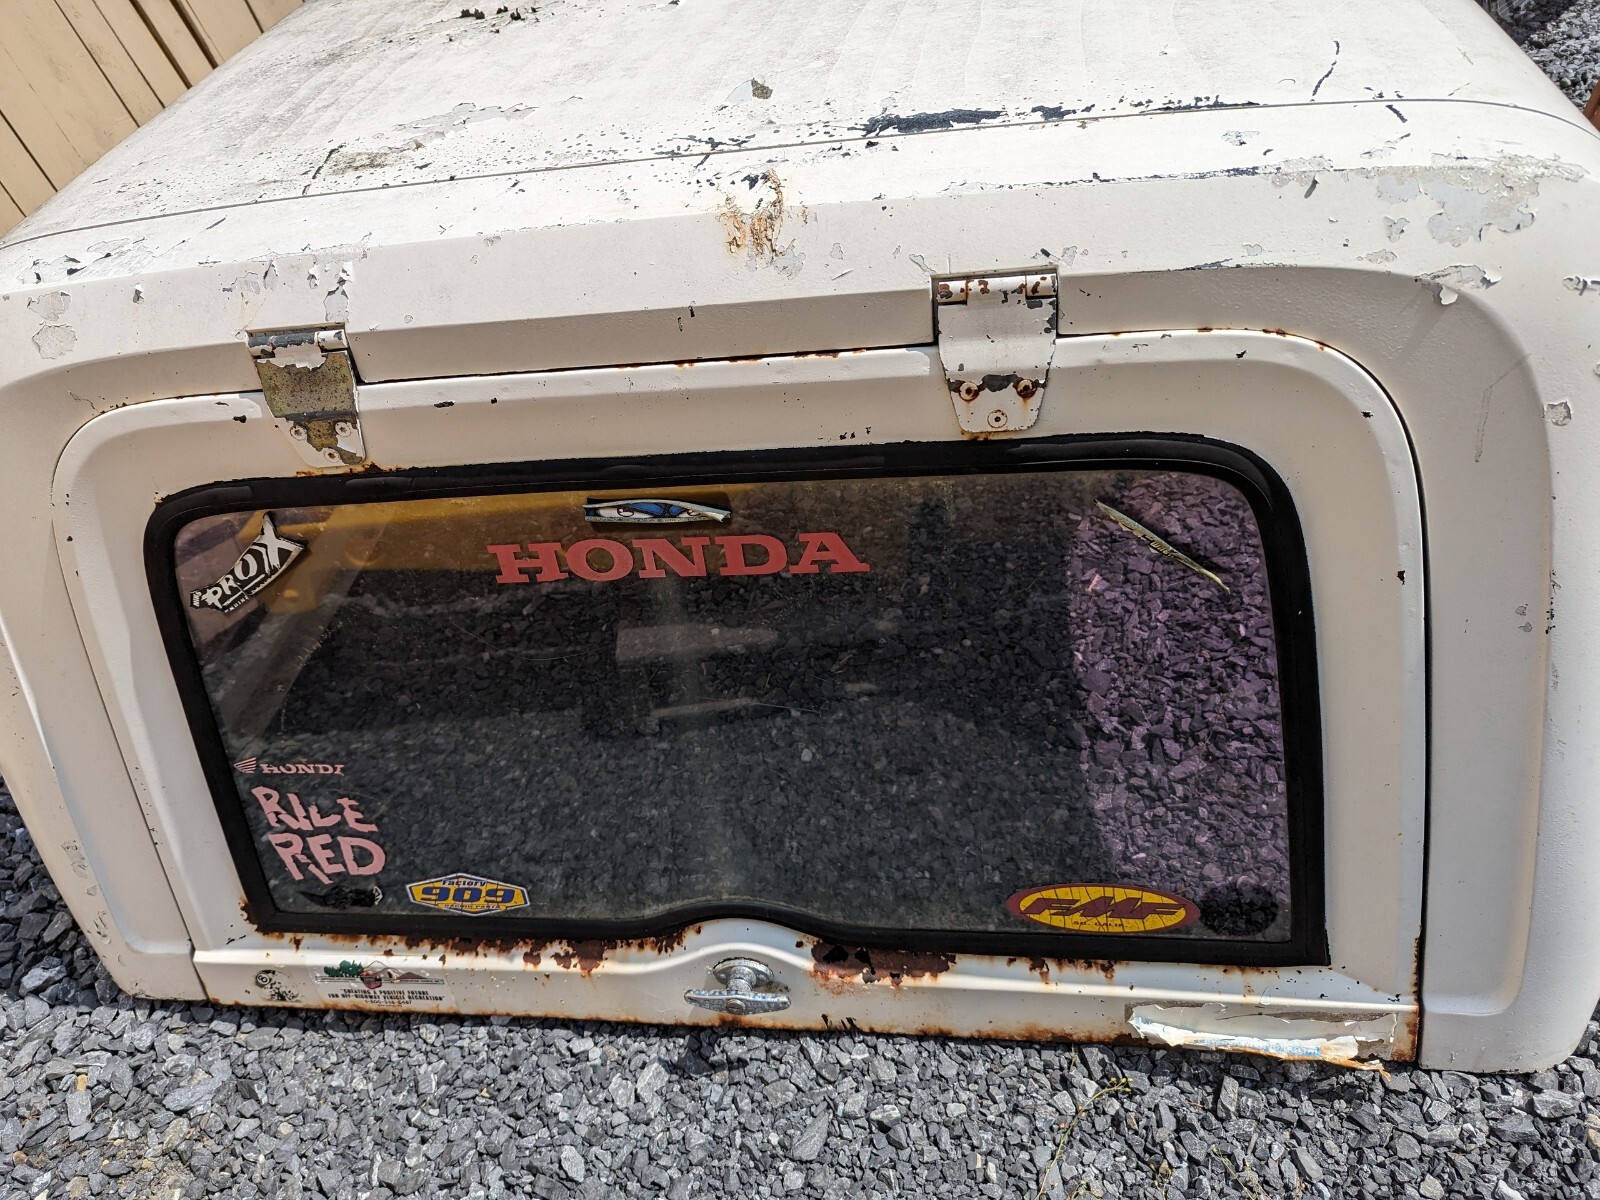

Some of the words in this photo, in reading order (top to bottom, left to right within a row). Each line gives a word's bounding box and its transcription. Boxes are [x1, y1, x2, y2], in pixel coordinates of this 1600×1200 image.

[487, 532, 871, 584] HONDA
[268, 832, 386, 884] RED
[420, 886, 516, 903] 909
[1020, 896, 1188, 919] FMF
